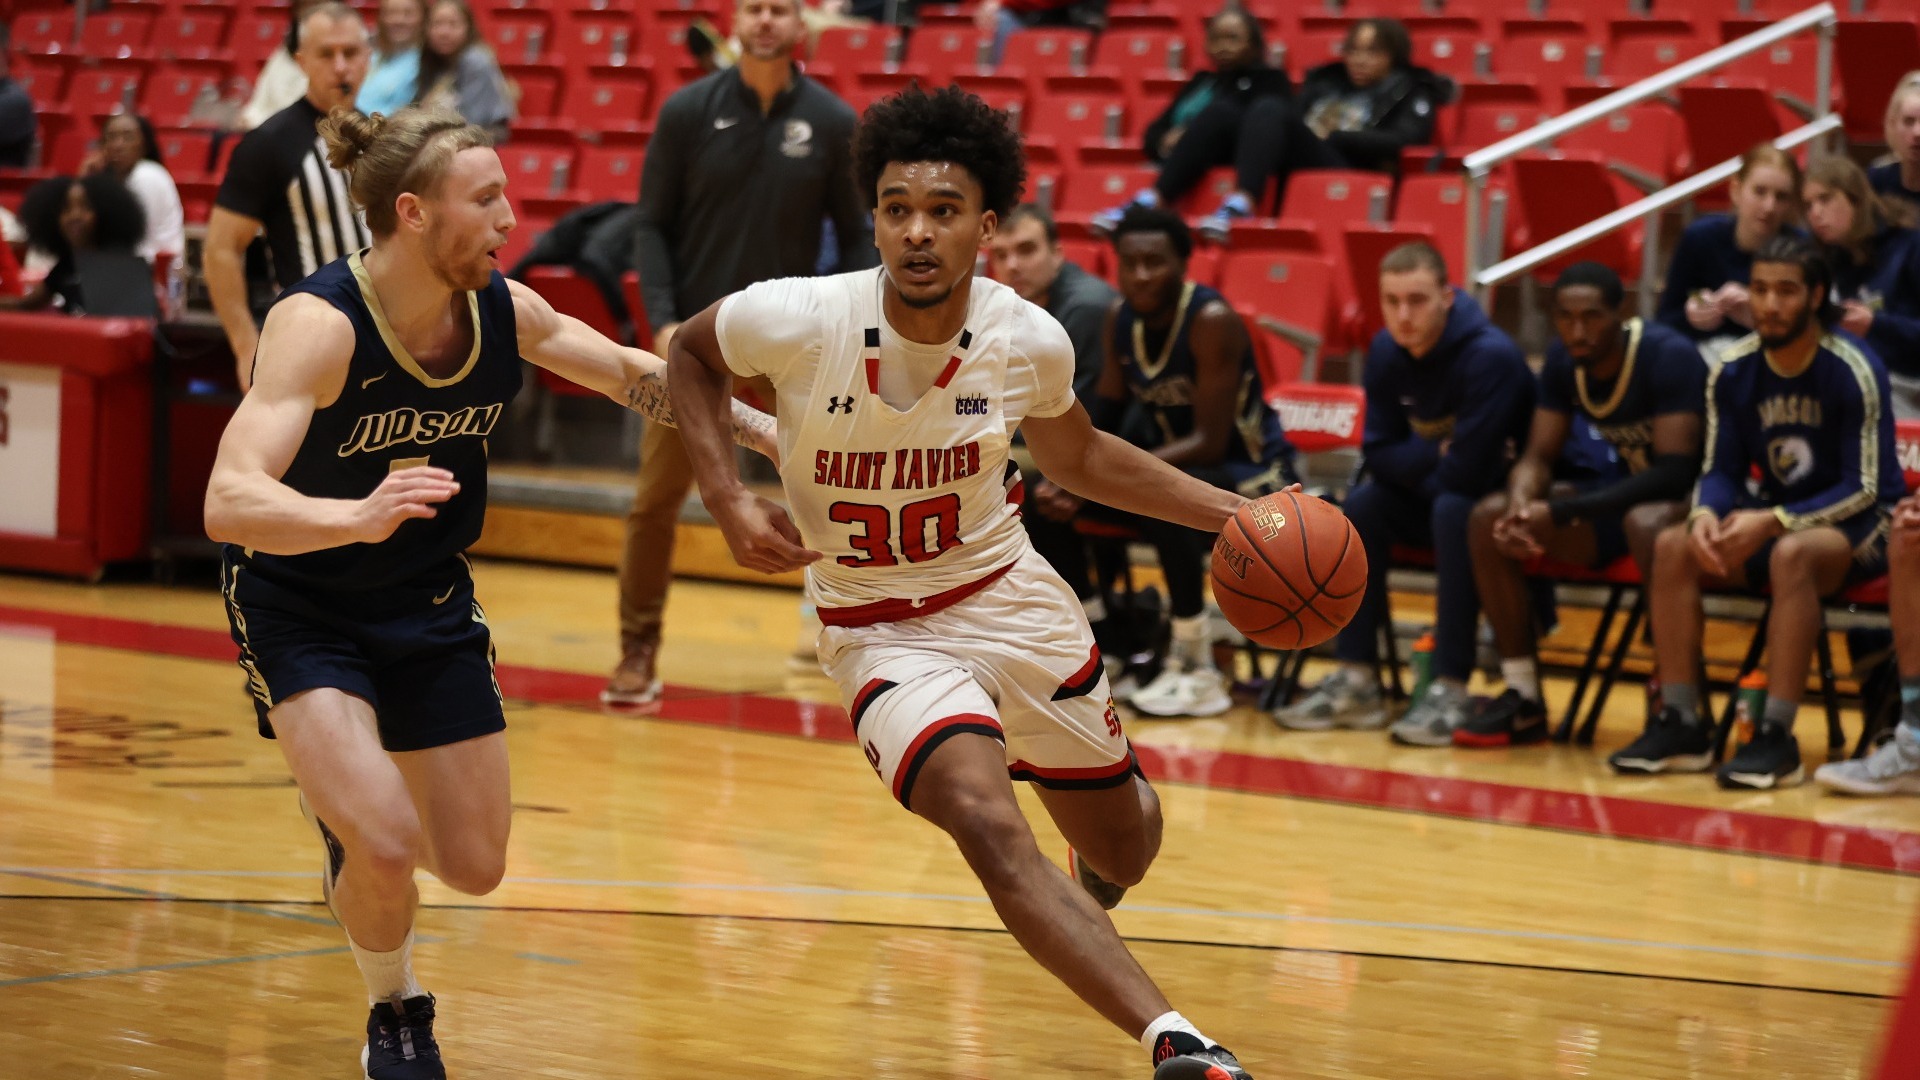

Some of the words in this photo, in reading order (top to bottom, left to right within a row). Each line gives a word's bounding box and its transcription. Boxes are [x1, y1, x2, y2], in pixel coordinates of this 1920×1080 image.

[337, 402, 503, 458] JUDSON
[955, 394, 989, 416] CCAC
[814, 449, 888, 491] SAINT
[891, 440, 981, 490] XAVIER
[828, 492, 964, 568] 30
